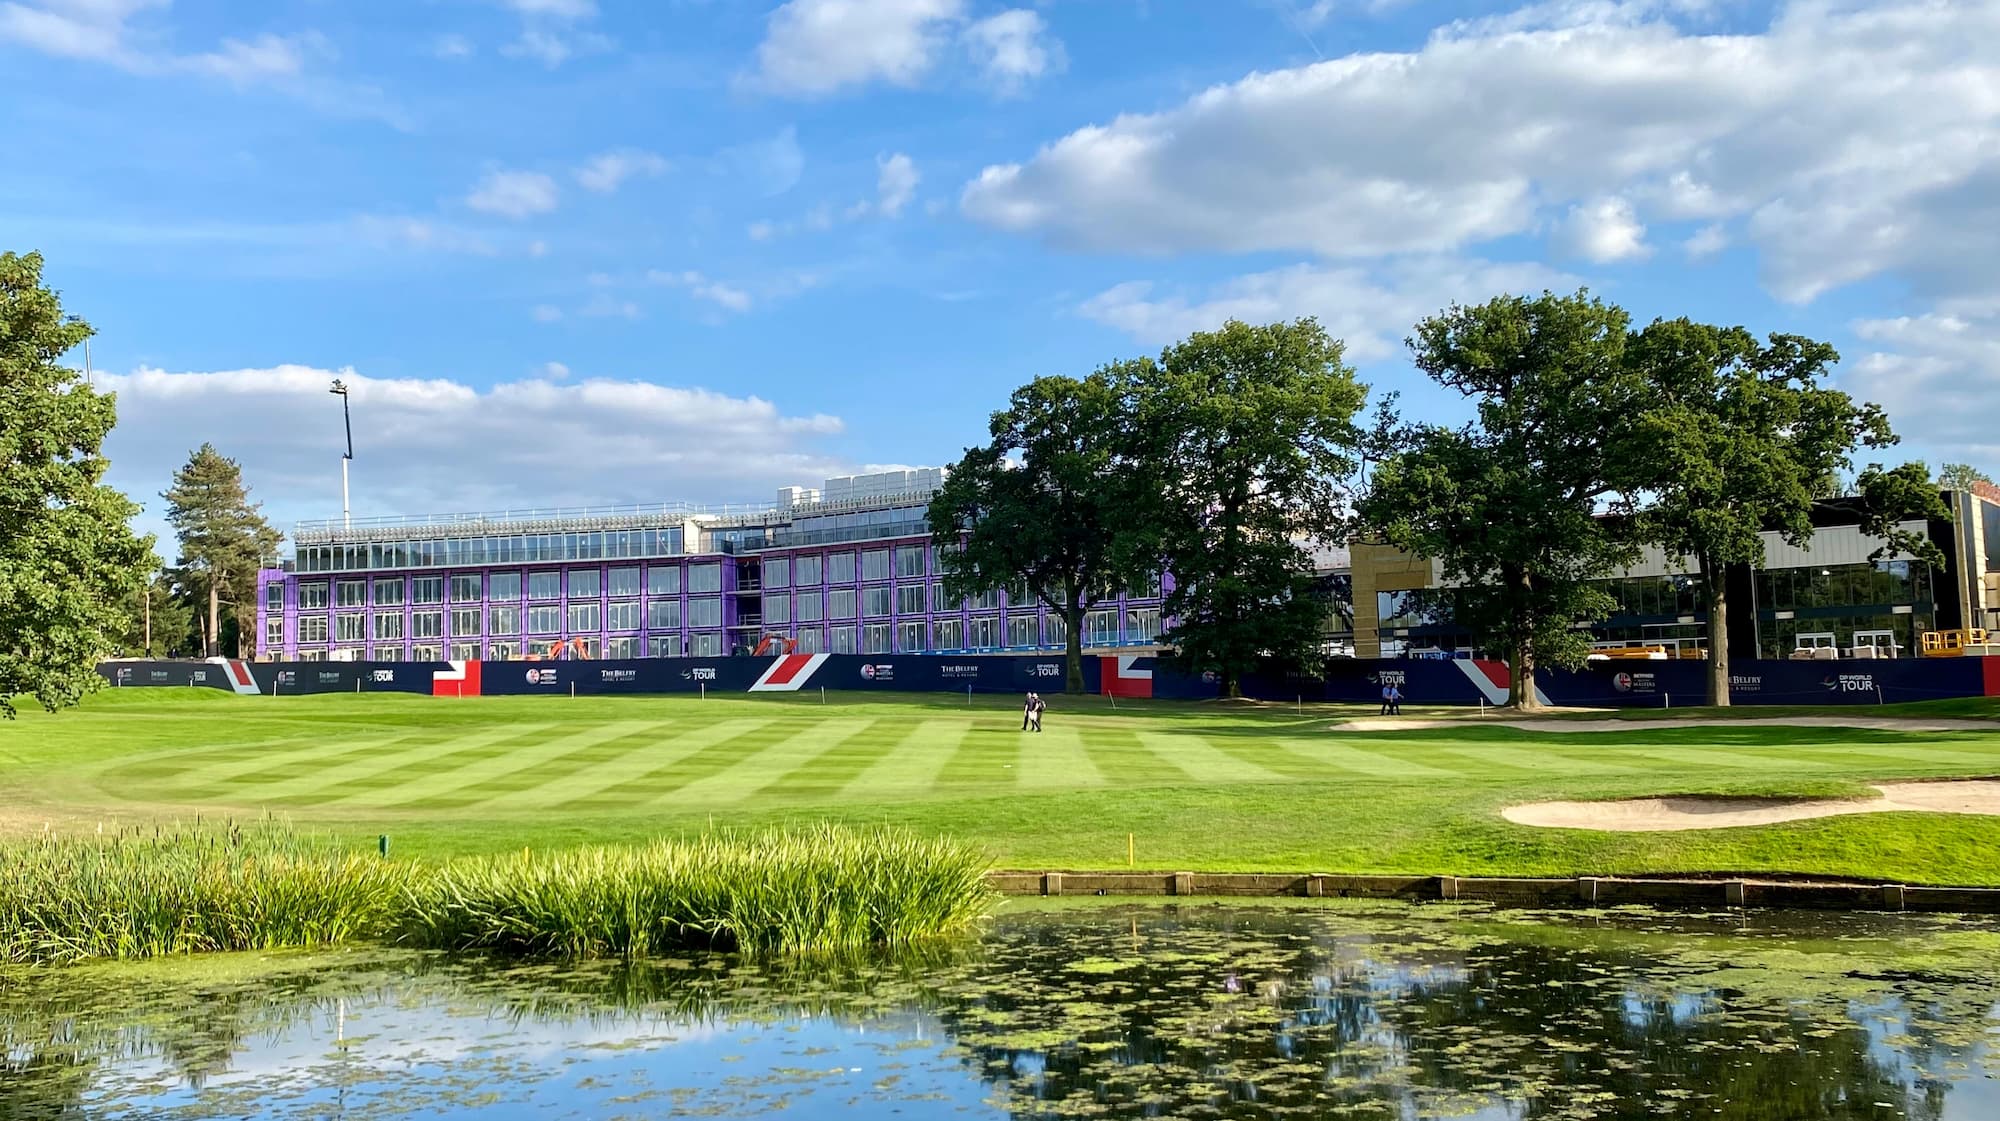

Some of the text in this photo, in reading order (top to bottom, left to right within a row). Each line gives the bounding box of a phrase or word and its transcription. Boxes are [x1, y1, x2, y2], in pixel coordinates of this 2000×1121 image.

[693, 672, 715, 680] TOUR
[1037, 669, 1060, 677] TOUR
[374, 673, 393, 682] TOUR
[1380, 675, 1405, 685] TOUR
[1733, 676, 1761, 684] BELFRY
[1840, 681, 1873, 692] TOUR
